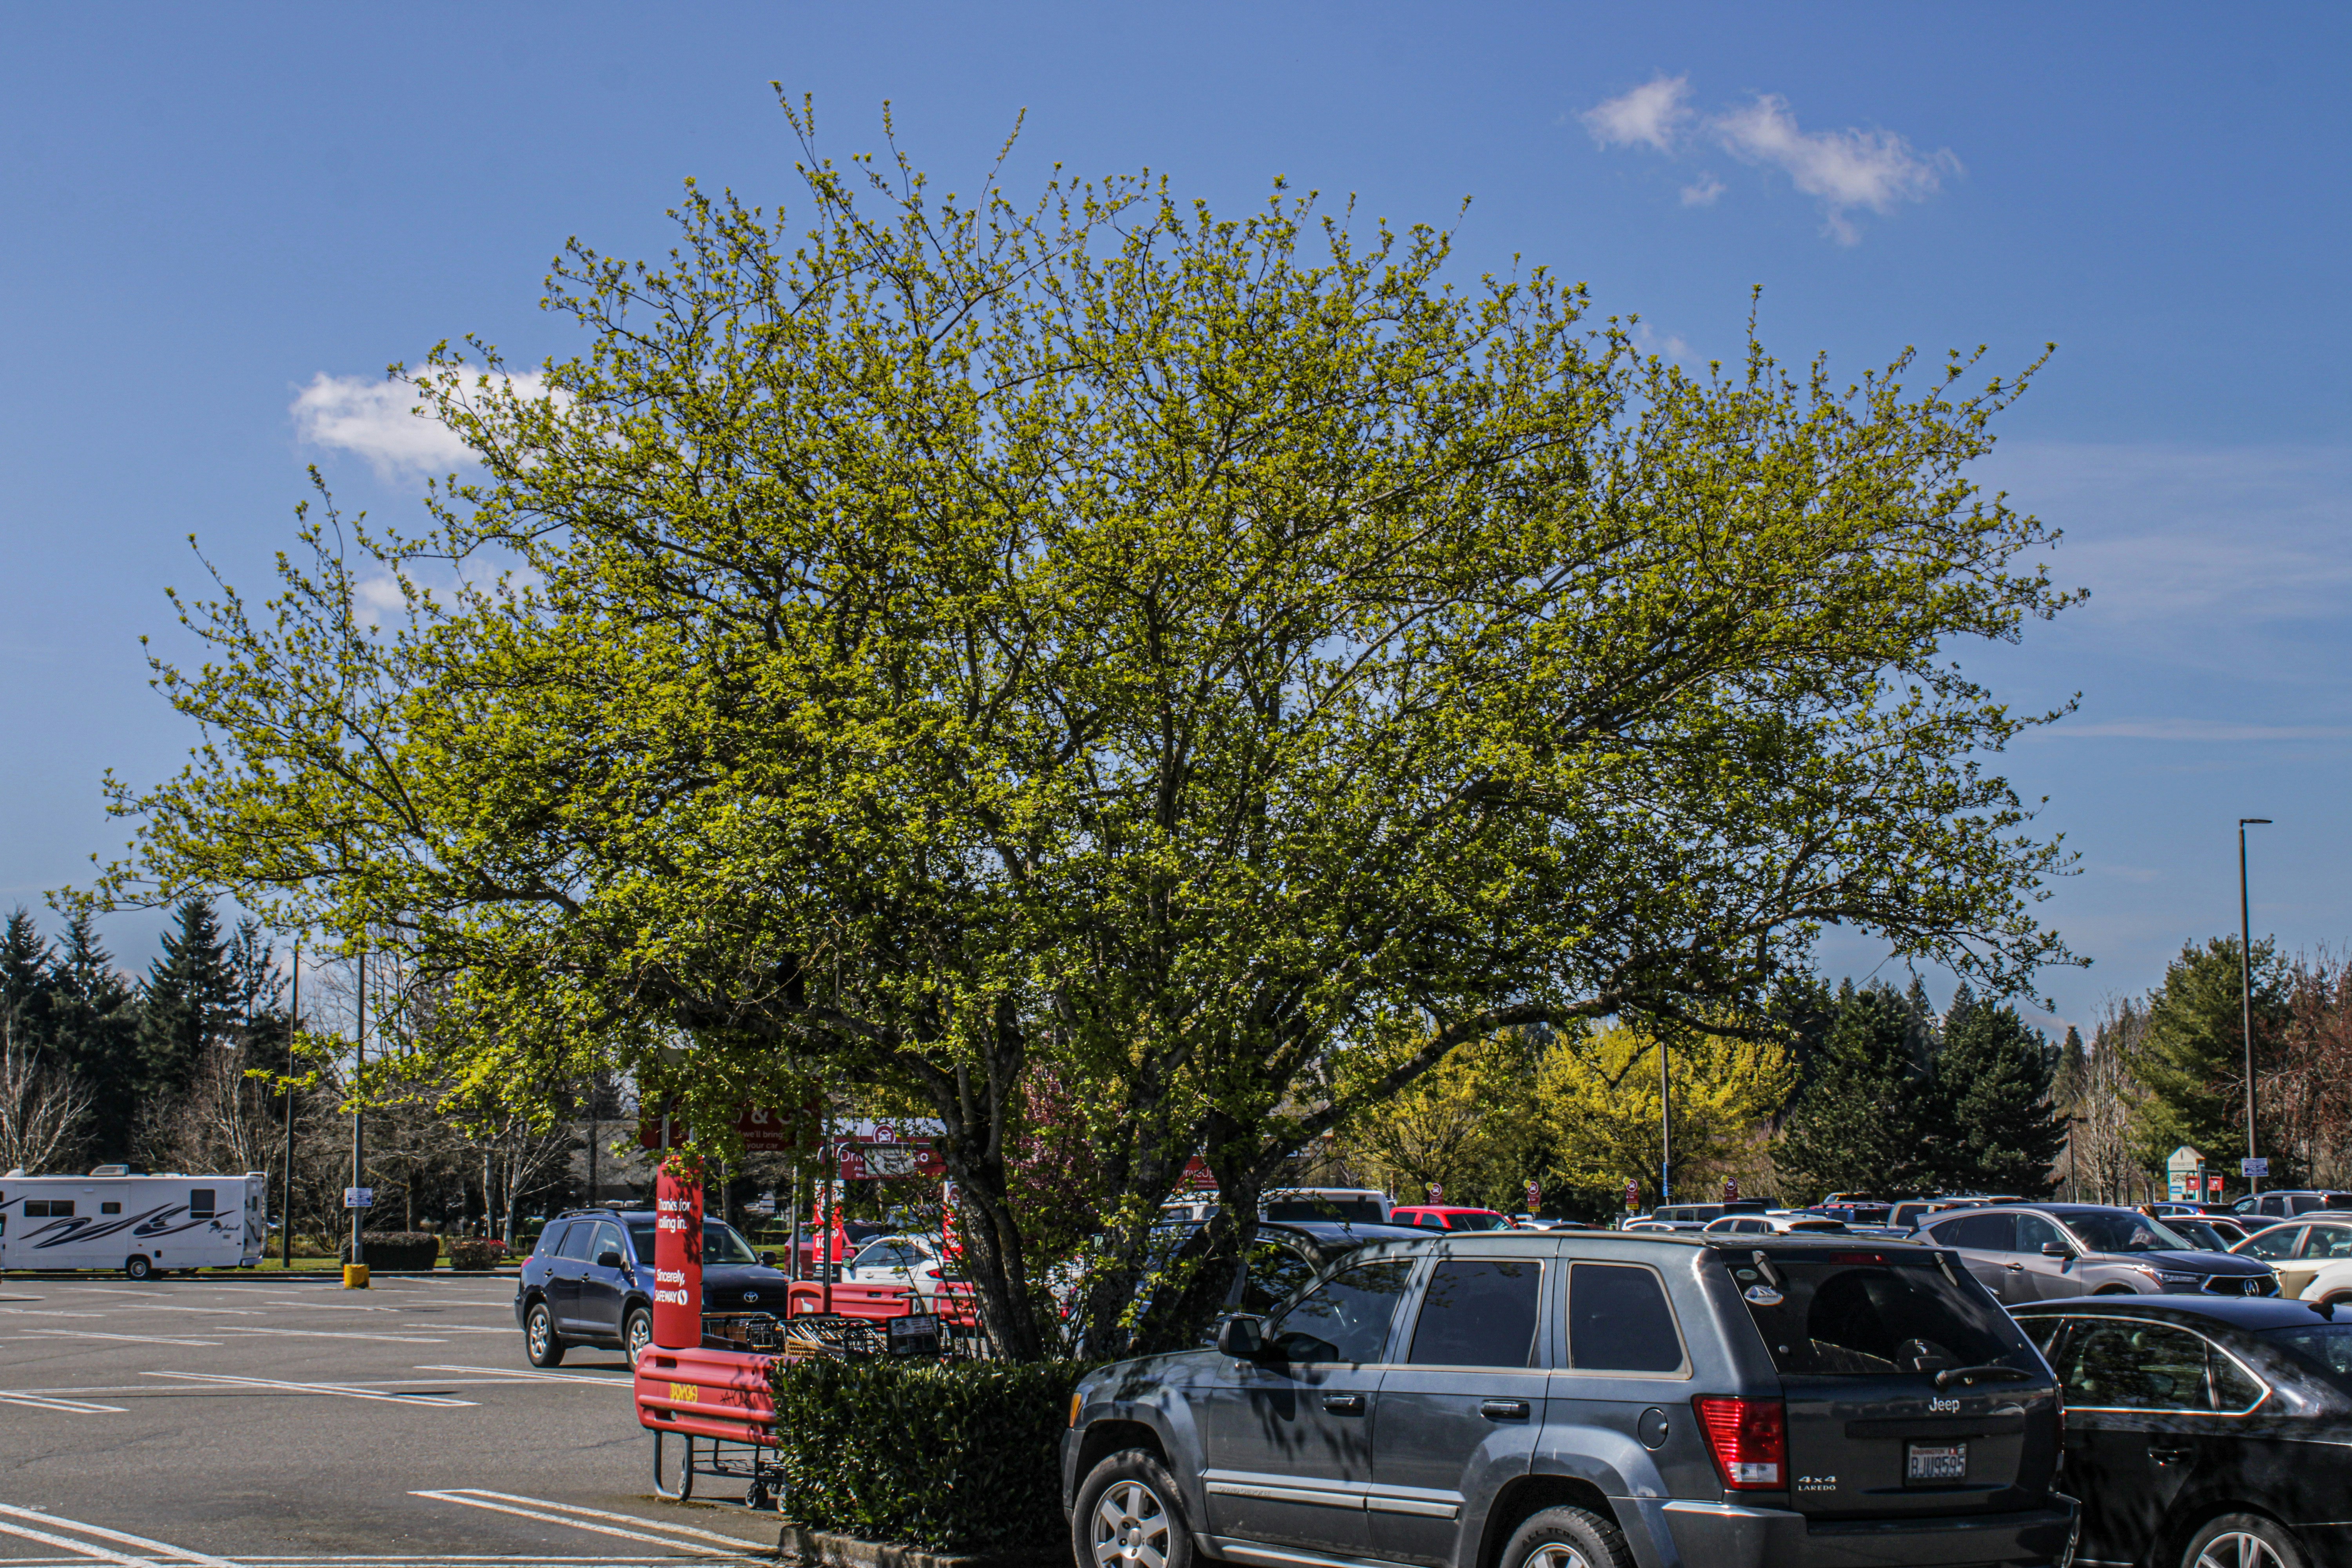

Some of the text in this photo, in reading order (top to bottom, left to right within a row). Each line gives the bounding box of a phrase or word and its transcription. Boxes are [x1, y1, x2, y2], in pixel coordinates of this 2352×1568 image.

[751, 1107, 768, 1124] &
[762, 1130, 783, 1140] bring
[658, 1198, 691, 1211] Thanks for
[658, 1216, 676, 1233] rolling
[657, 1268, 686, 1287] Sincerely,
[655, 1290, 678, 1303] SAFEWAY
[1928, 1396, 1960, 1414] Jeep
[1522, 1530, 1544, 1548] ALL
